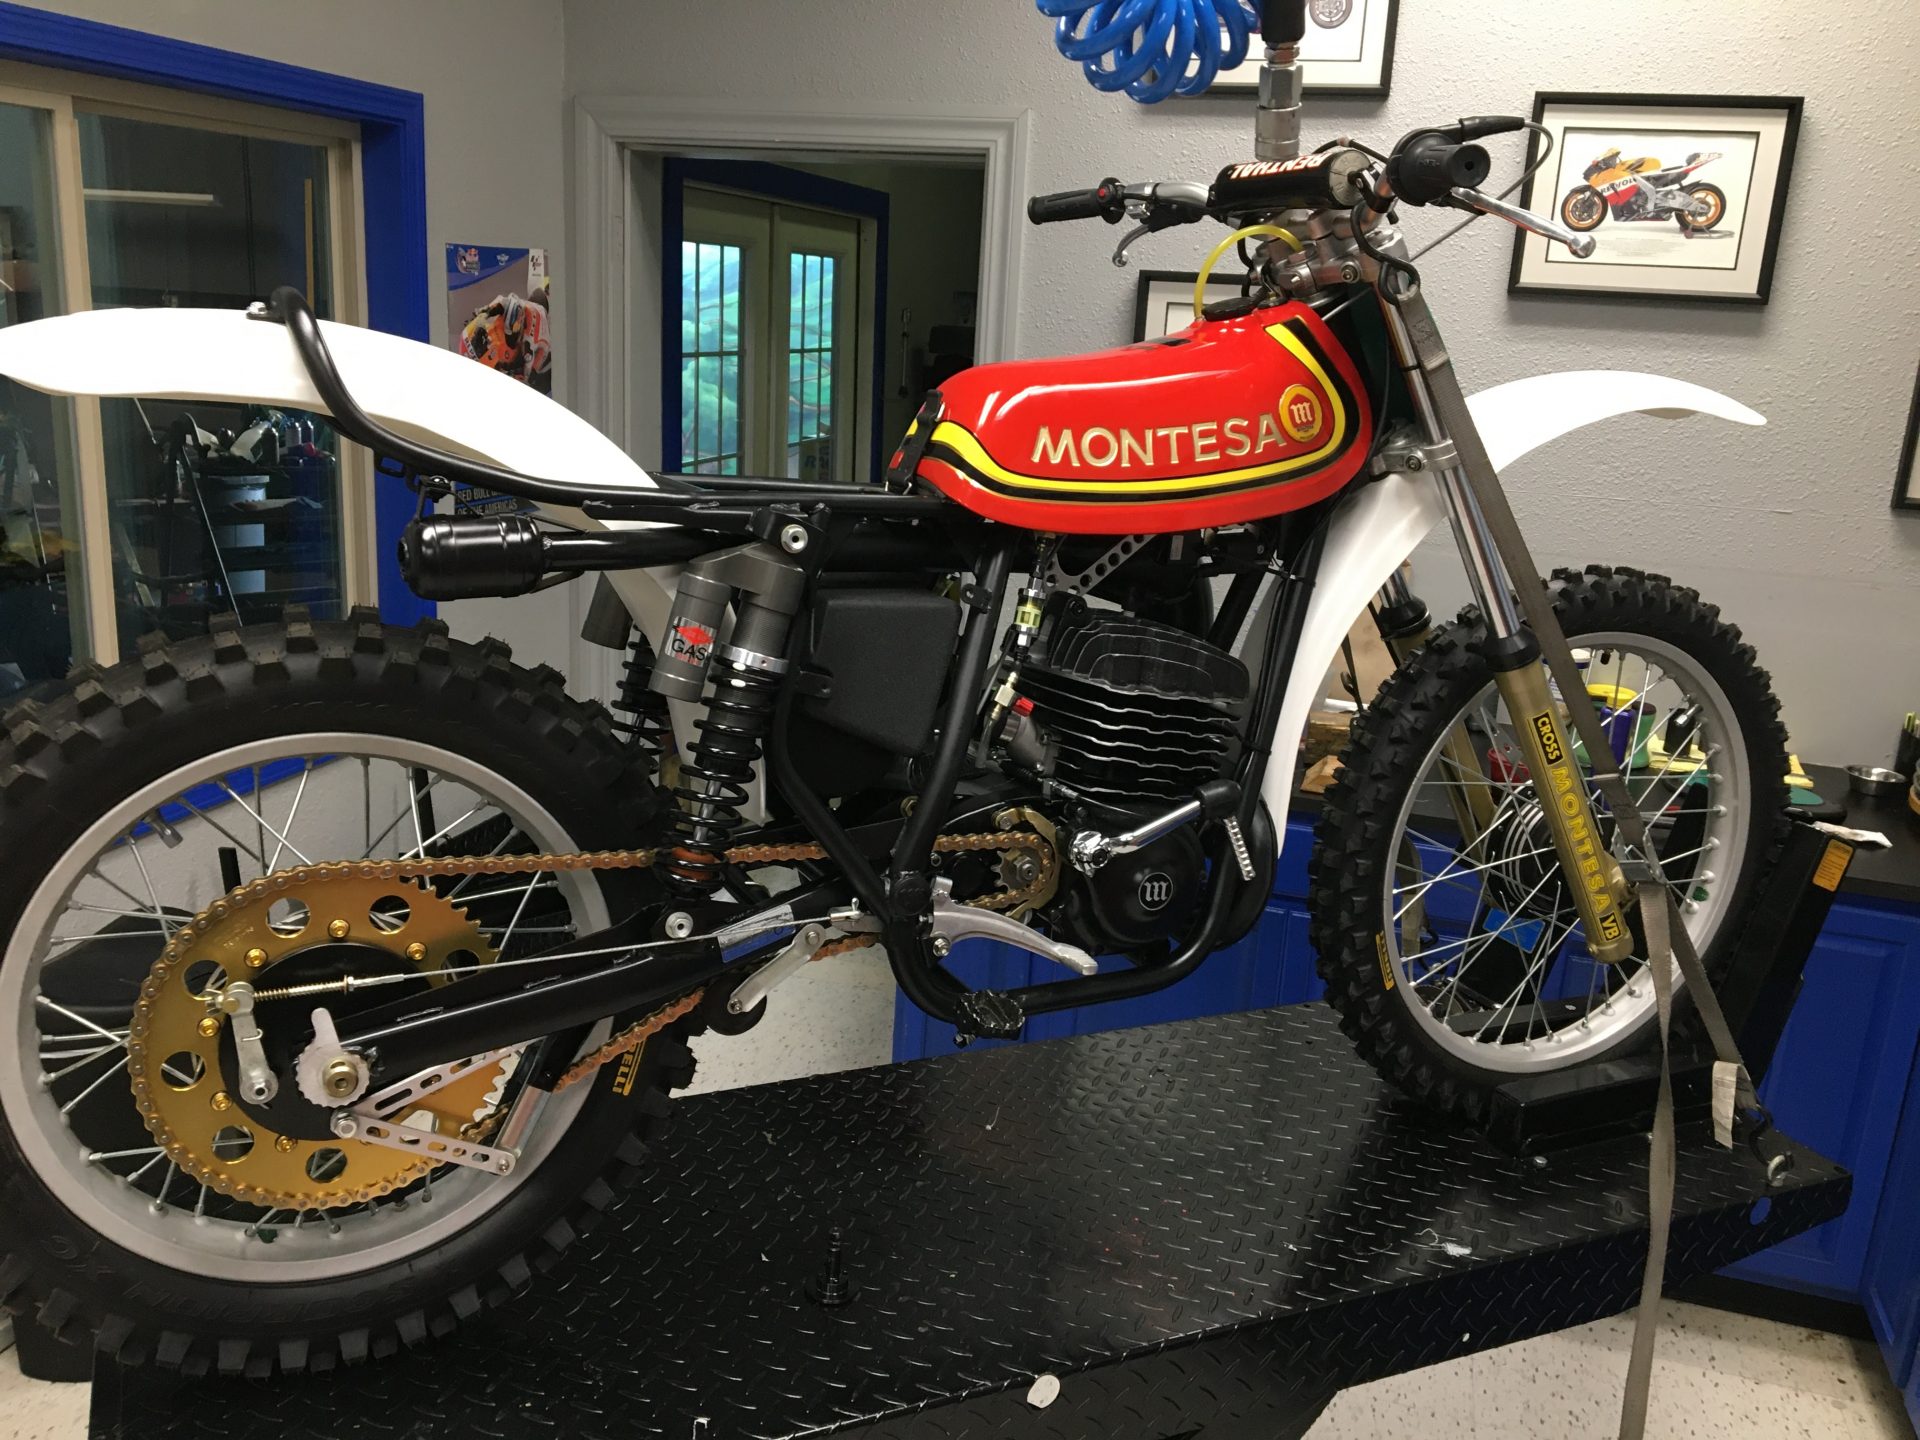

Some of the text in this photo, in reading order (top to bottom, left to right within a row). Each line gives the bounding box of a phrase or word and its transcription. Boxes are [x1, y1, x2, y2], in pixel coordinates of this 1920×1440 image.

[1230, 151, 1333, 179] RENTHAL
[1030, 413, 1287, 467] MONTESA
[672, 639, 707, 661] GAS
[1537, 716, 1621, 940] CROSS MONTESA VB
